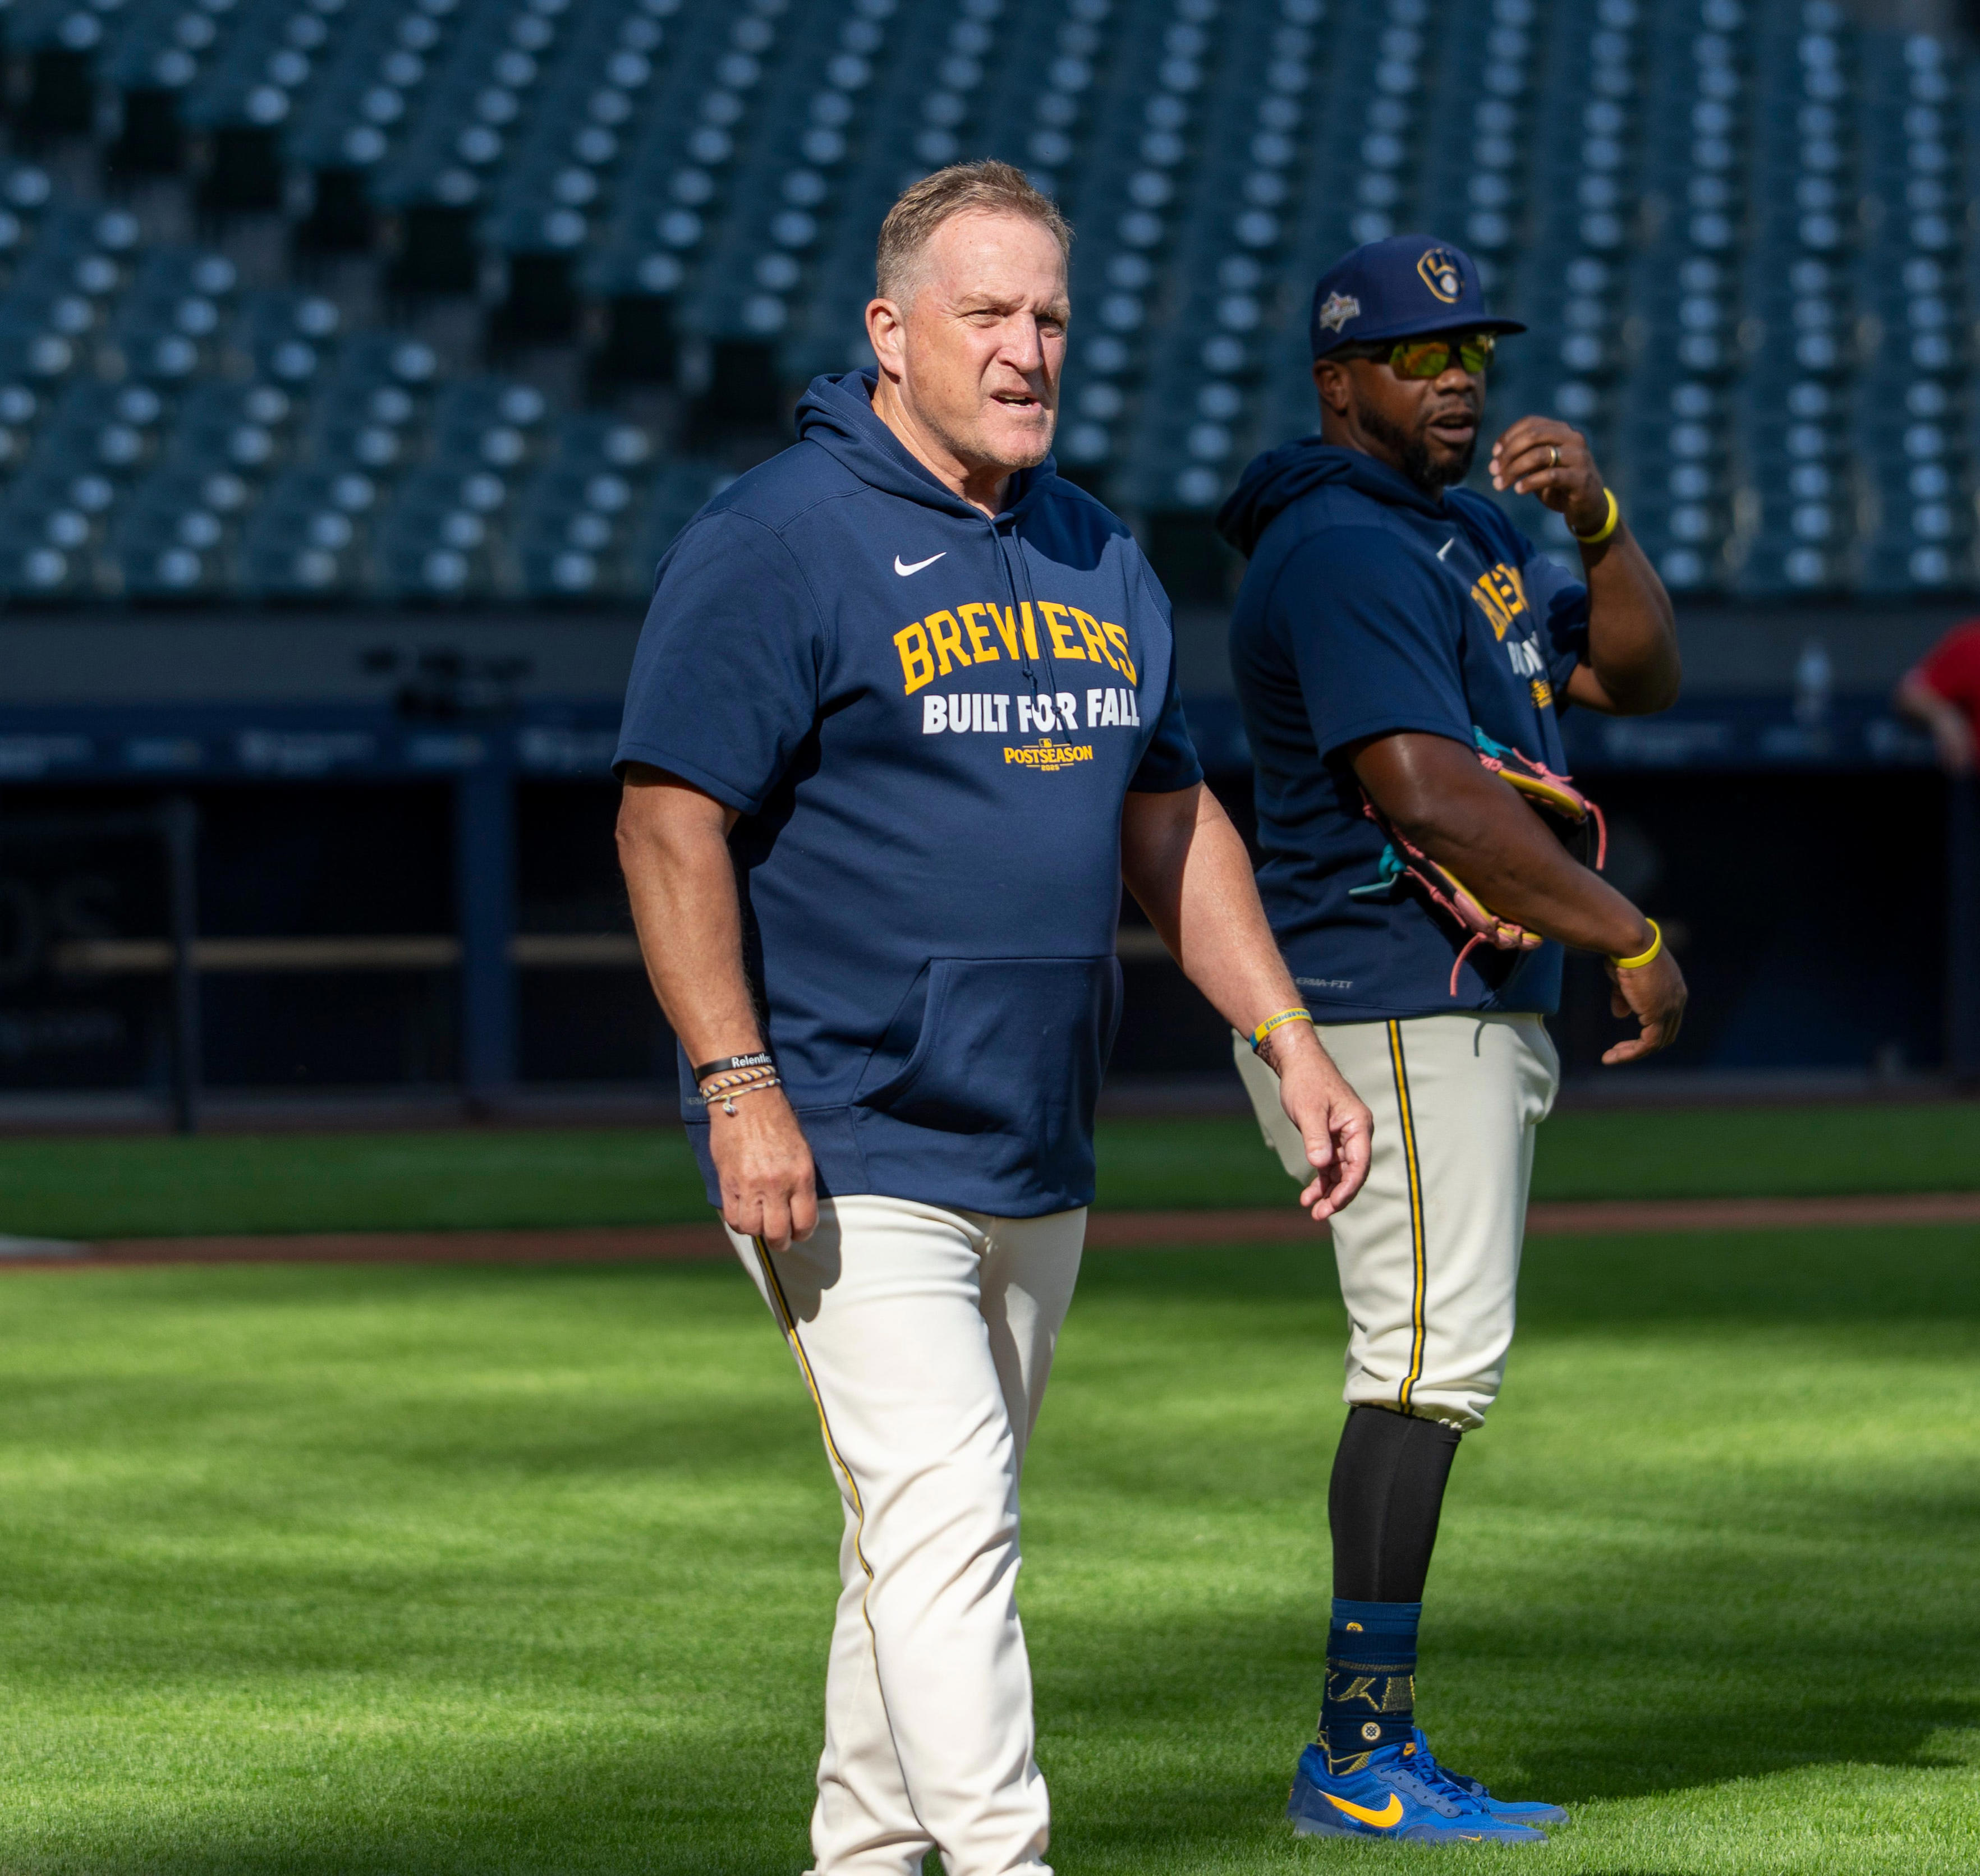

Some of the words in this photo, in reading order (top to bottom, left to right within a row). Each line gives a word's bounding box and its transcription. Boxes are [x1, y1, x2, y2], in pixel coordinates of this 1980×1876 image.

[893, 601, 1137, 696] BREWERS
[923, 693, 1010, 734] BUILT
[1017, 692, 1079, 733] FOR
[1087, 688, 1140, 728] FALL
[1003, 745, 1094, 764] POSTSEASON
